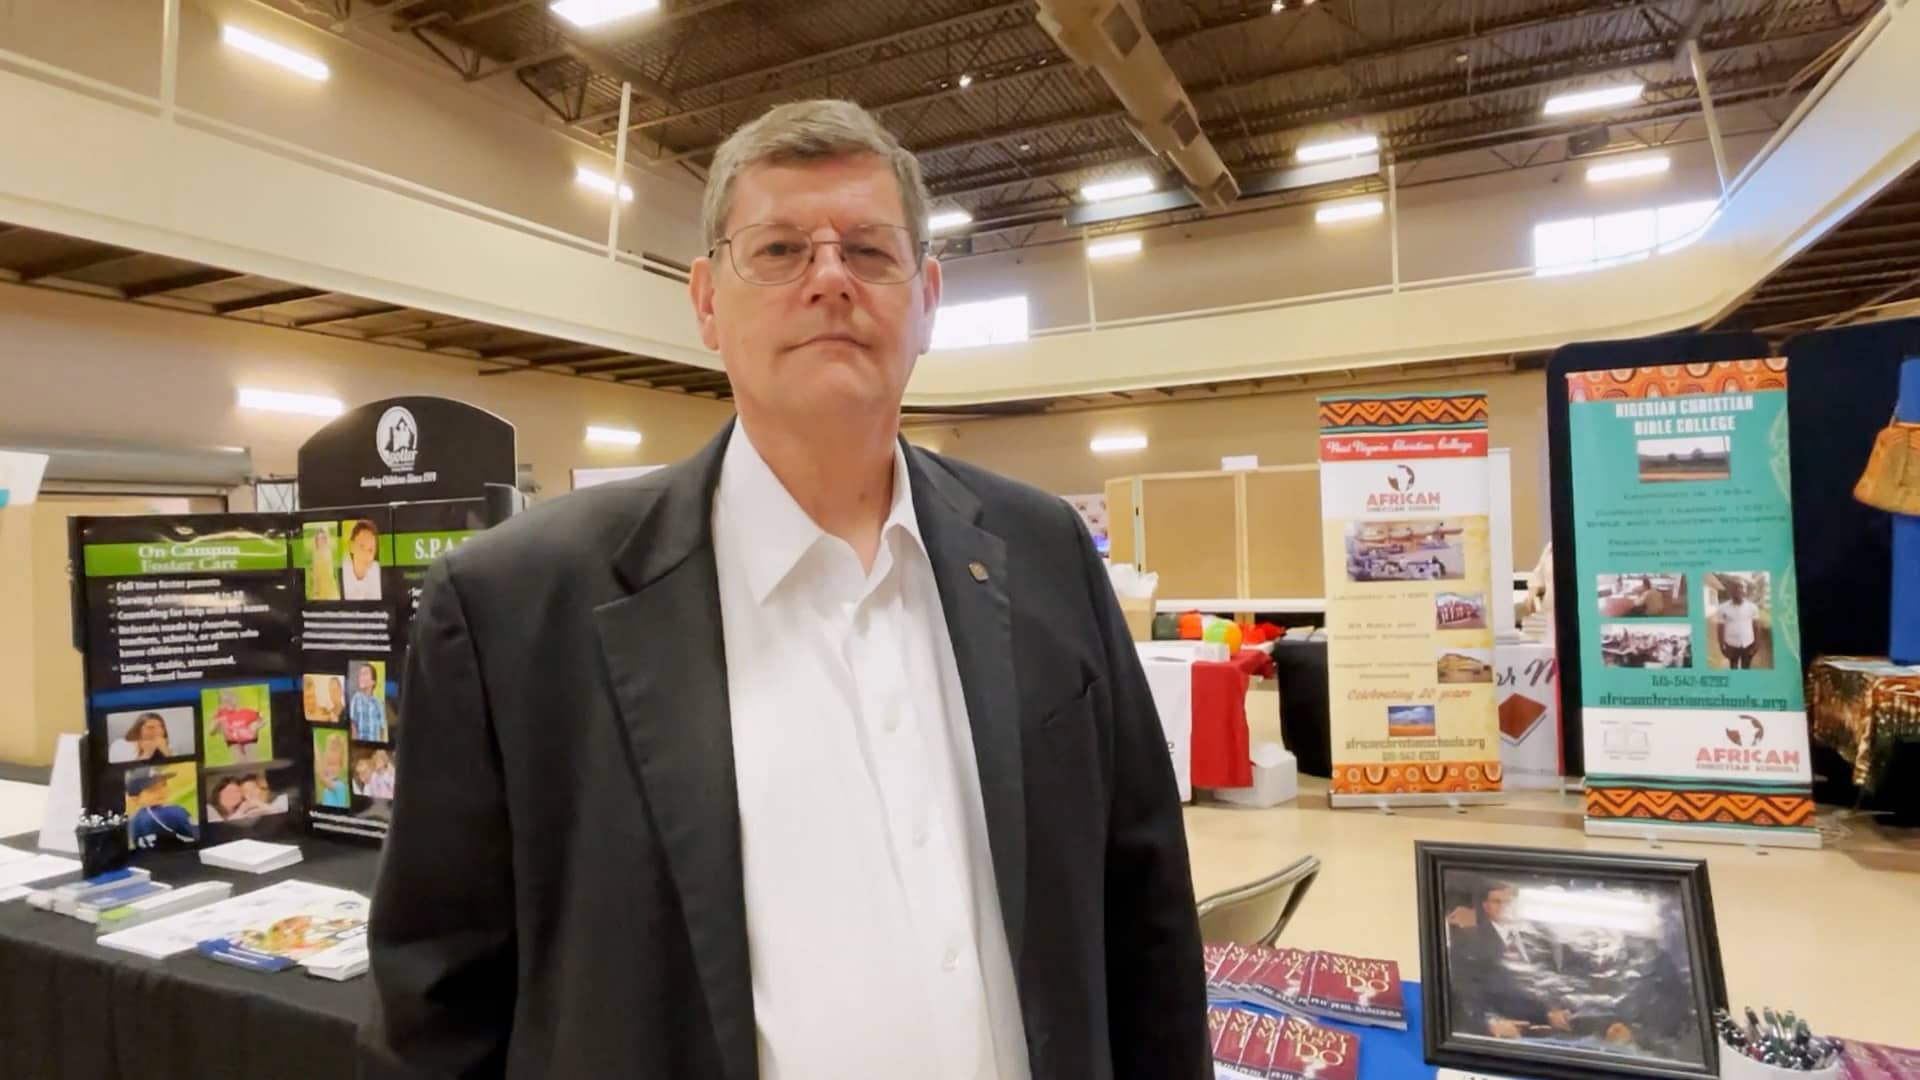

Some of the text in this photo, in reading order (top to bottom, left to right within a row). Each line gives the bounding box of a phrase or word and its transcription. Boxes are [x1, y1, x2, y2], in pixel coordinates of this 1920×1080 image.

[1615, 396, 1754, 418] NIGERIAN CHRISTIAN
[1634, 416, 1736, 435] BIBLE COLLEGE
[1367, 491, 1441, 505] AFRICAN
[139, 544, 240, 559] On Campus
[142, 558, 239, 575] Foster Care
[1347, 688, 1415, 701] Celebrating
[1439, 689, 1473, 702] years
[1599, 692, 1788, 711] africanchristianschools.org
[1696, 747, 1800, 765] AFRICAN
[1346, 974, 1390, 993] DO
[1295, 1041, 1344, 1066] DO
